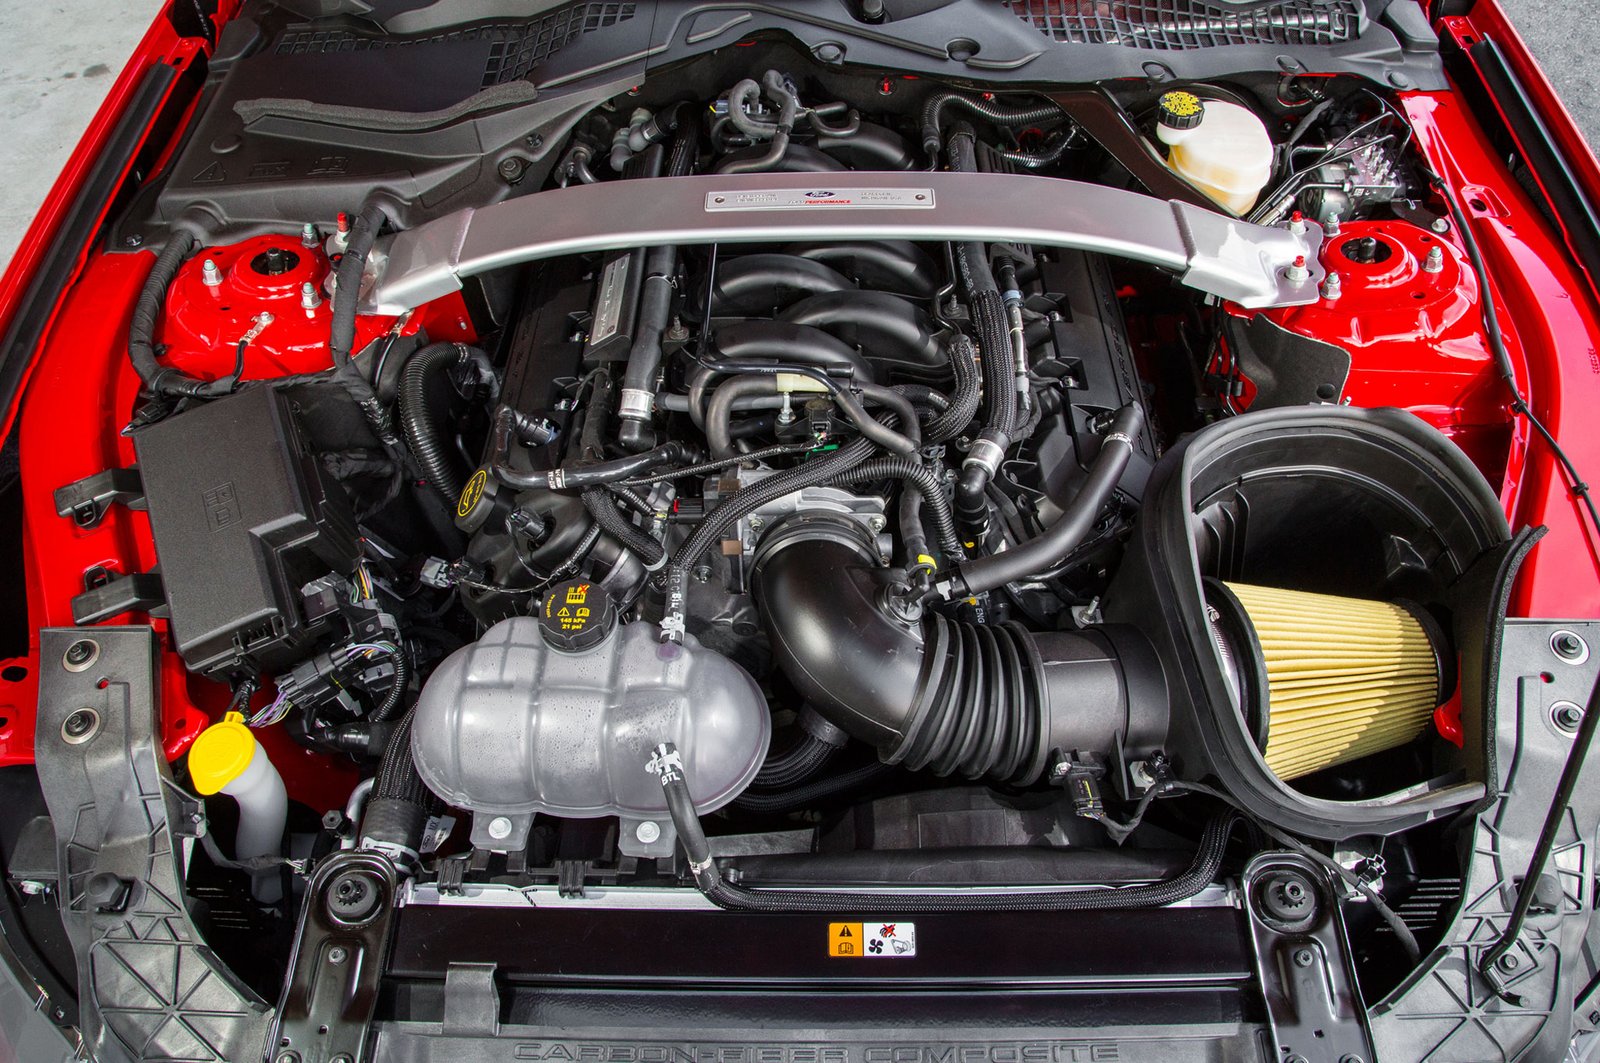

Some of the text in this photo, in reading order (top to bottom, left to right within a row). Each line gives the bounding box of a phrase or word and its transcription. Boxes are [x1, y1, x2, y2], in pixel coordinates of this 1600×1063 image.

[975, 608, 985, 623] ENG
[661, 772, 681, 786] BTL
[864, 1043, 1120, 1063] COMPOSITE
